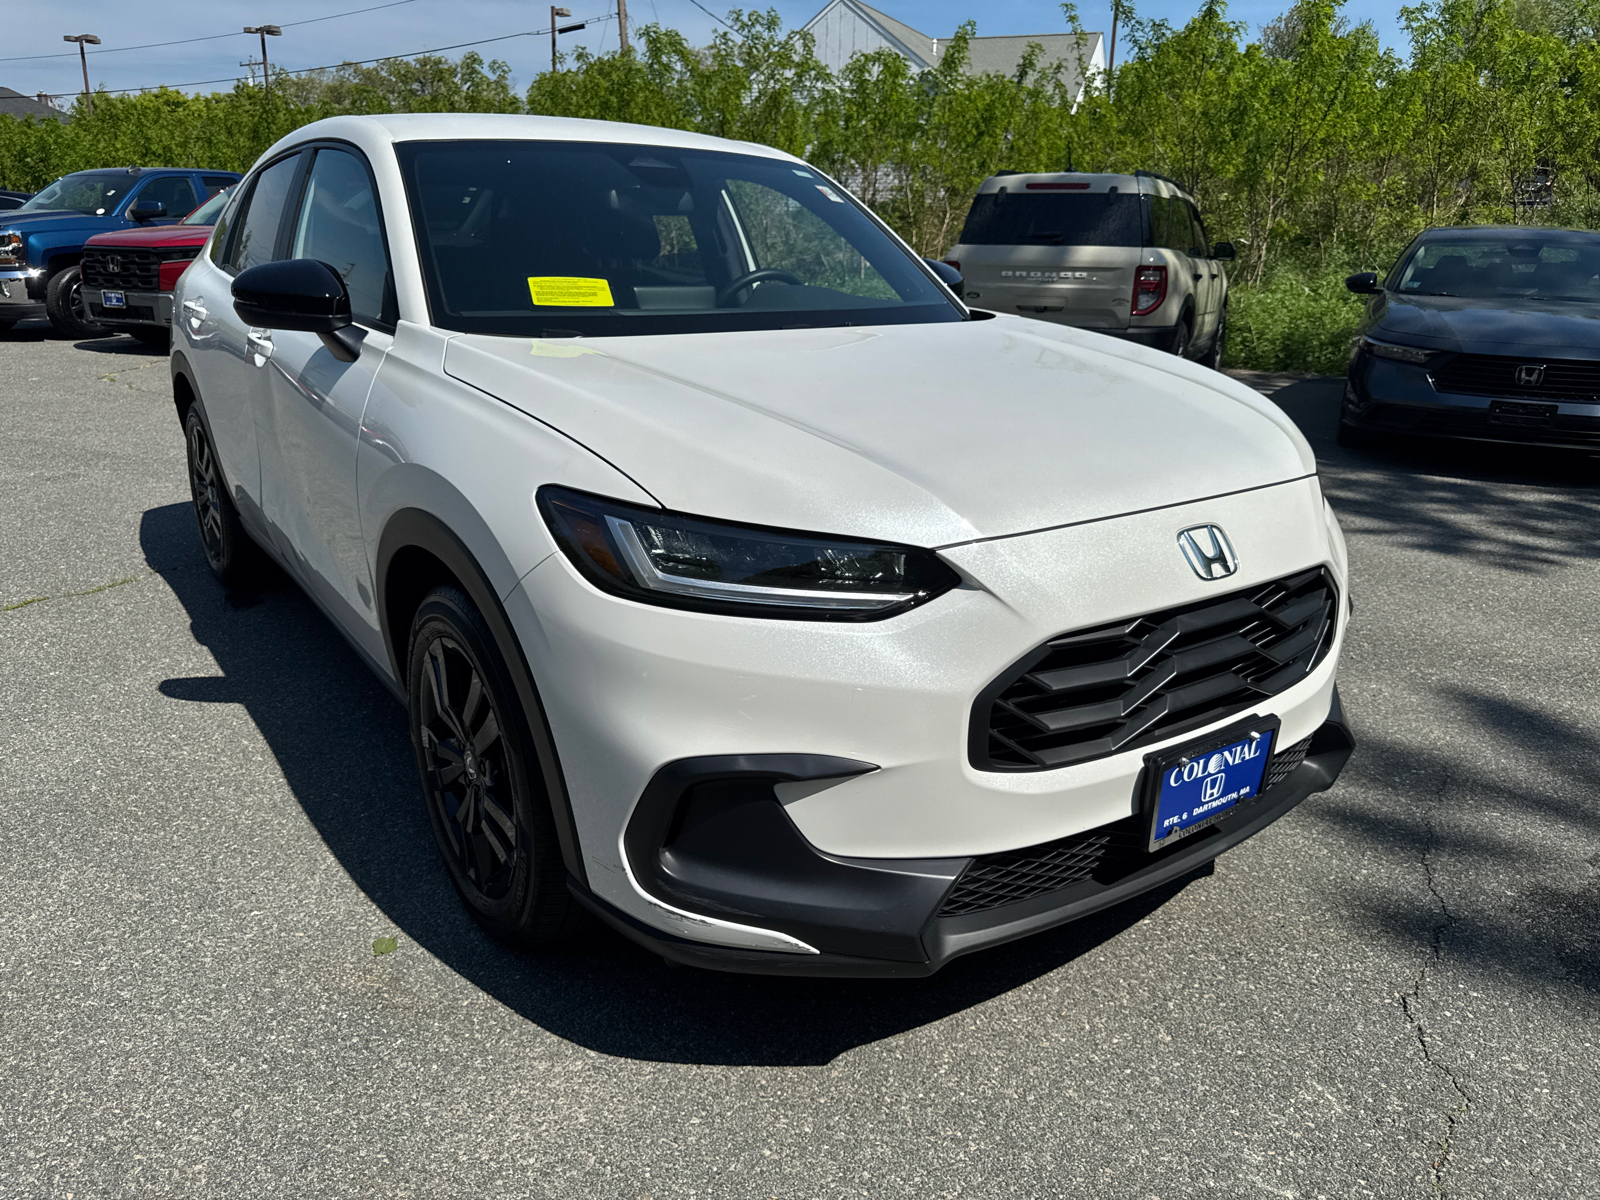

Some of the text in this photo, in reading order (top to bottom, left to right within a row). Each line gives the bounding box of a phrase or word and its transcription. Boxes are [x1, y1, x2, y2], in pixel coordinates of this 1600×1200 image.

[1001, 271, 1087, 279] BRONCO
[1169, 738, 1261, 787] COLONIAL
[1163, 816, 1181, 828] RTE.
[1182, 812, 1188, 820] 6
[1193, 792, 1238, 816] DARTMOUTH,
[1239, 786, 1250, 797] MA
